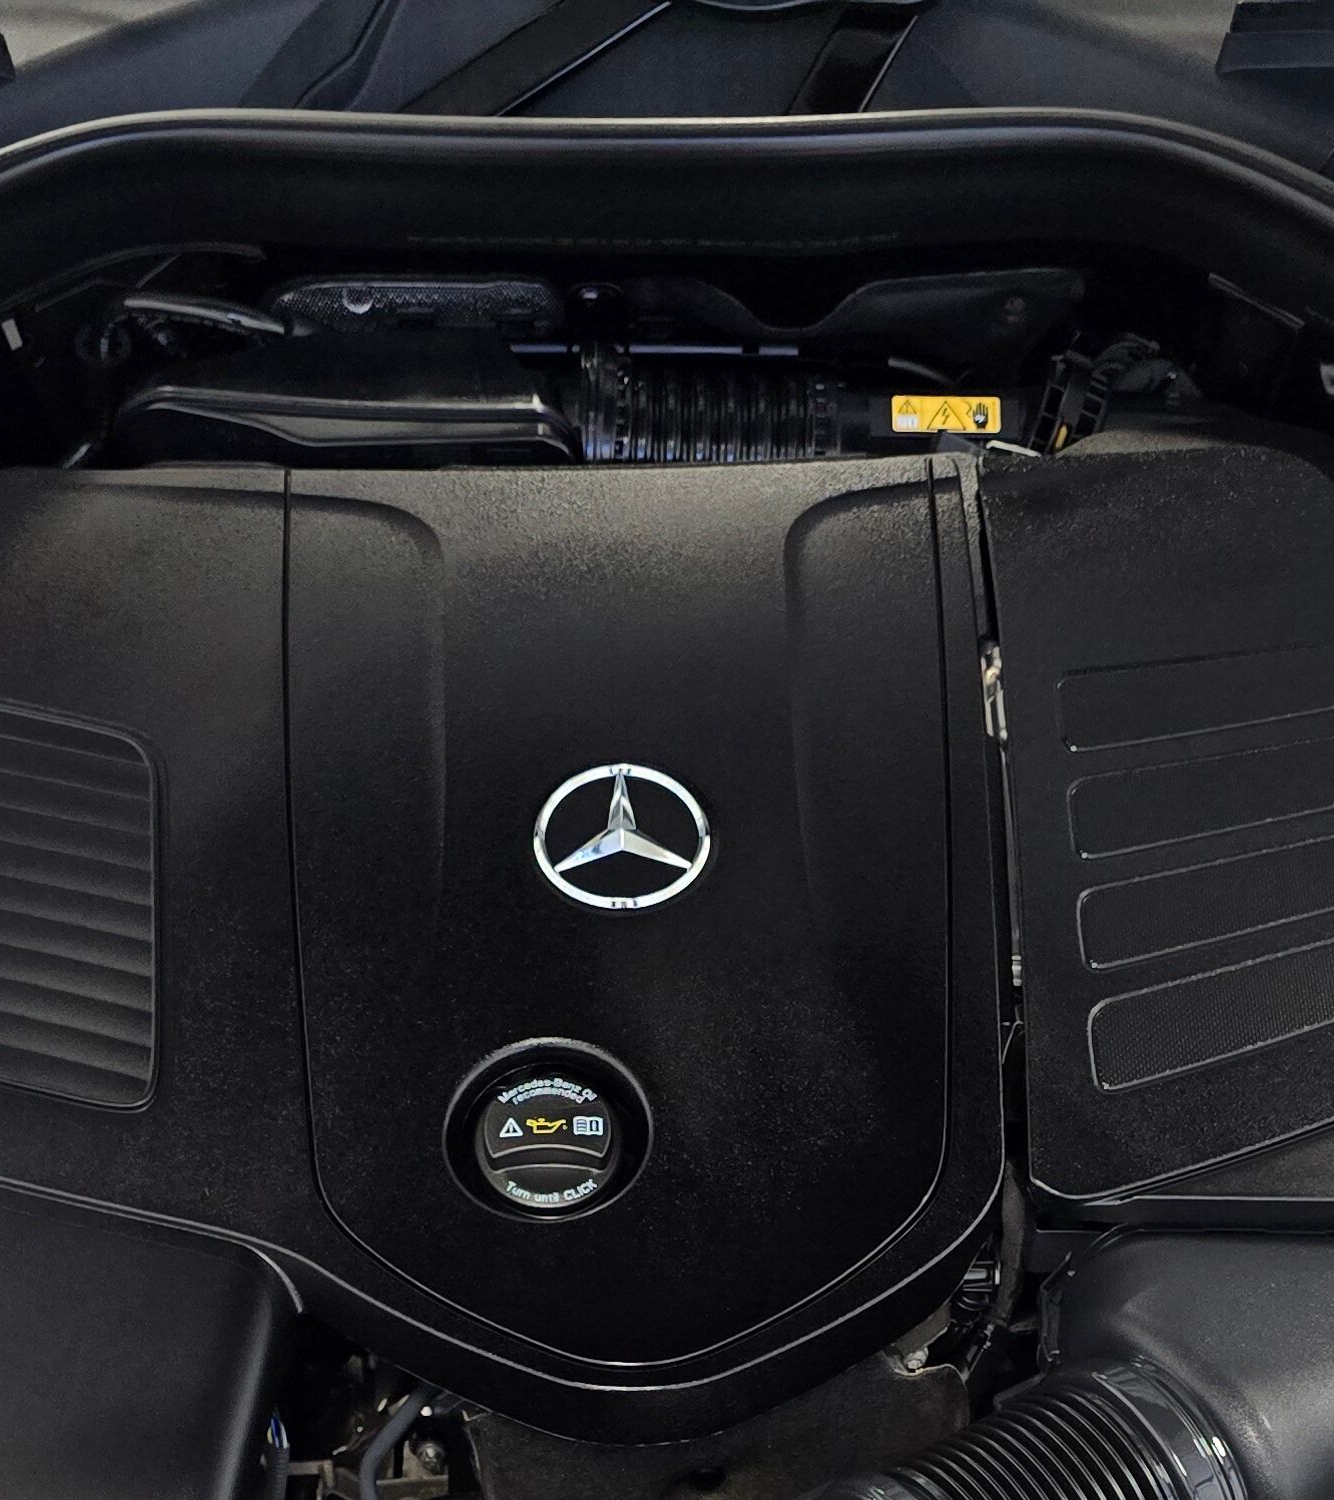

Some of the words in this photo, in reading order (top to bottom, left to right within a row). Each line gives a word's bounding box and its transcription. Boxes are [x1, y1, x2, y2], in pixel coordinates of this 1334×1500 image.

[497, 1077, 582, 1104] Mercedes-Benz
[512, 1086, 586, 1106] recommended
[505, 1180, 531, 1200] Turn
[533, 1190, 560, 1203] until
[563, 1178, 598, 1202] CLICK
